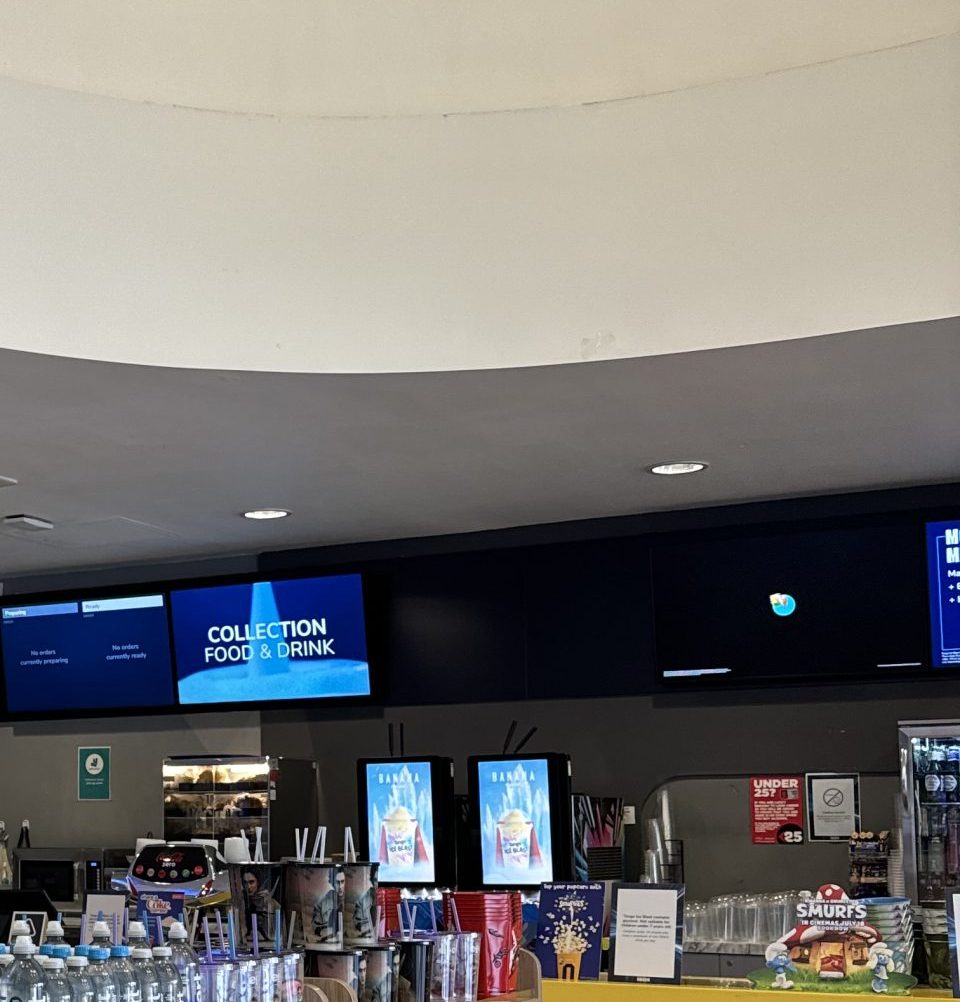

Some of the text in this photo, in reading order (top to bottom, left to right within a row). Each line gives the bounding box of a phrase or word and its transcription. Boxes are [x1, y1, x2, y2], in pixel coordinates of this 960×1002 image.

[207, 618, 327, 644] COLLECTION
[204, 638, 336, 663] FOOD & DRINK
[753, 779, 799, 788] UNDER
[754, 788, 777, 798] 25?
[784, 831, 803, 843] 25
[796, 902, 867, 919] SMURFS
